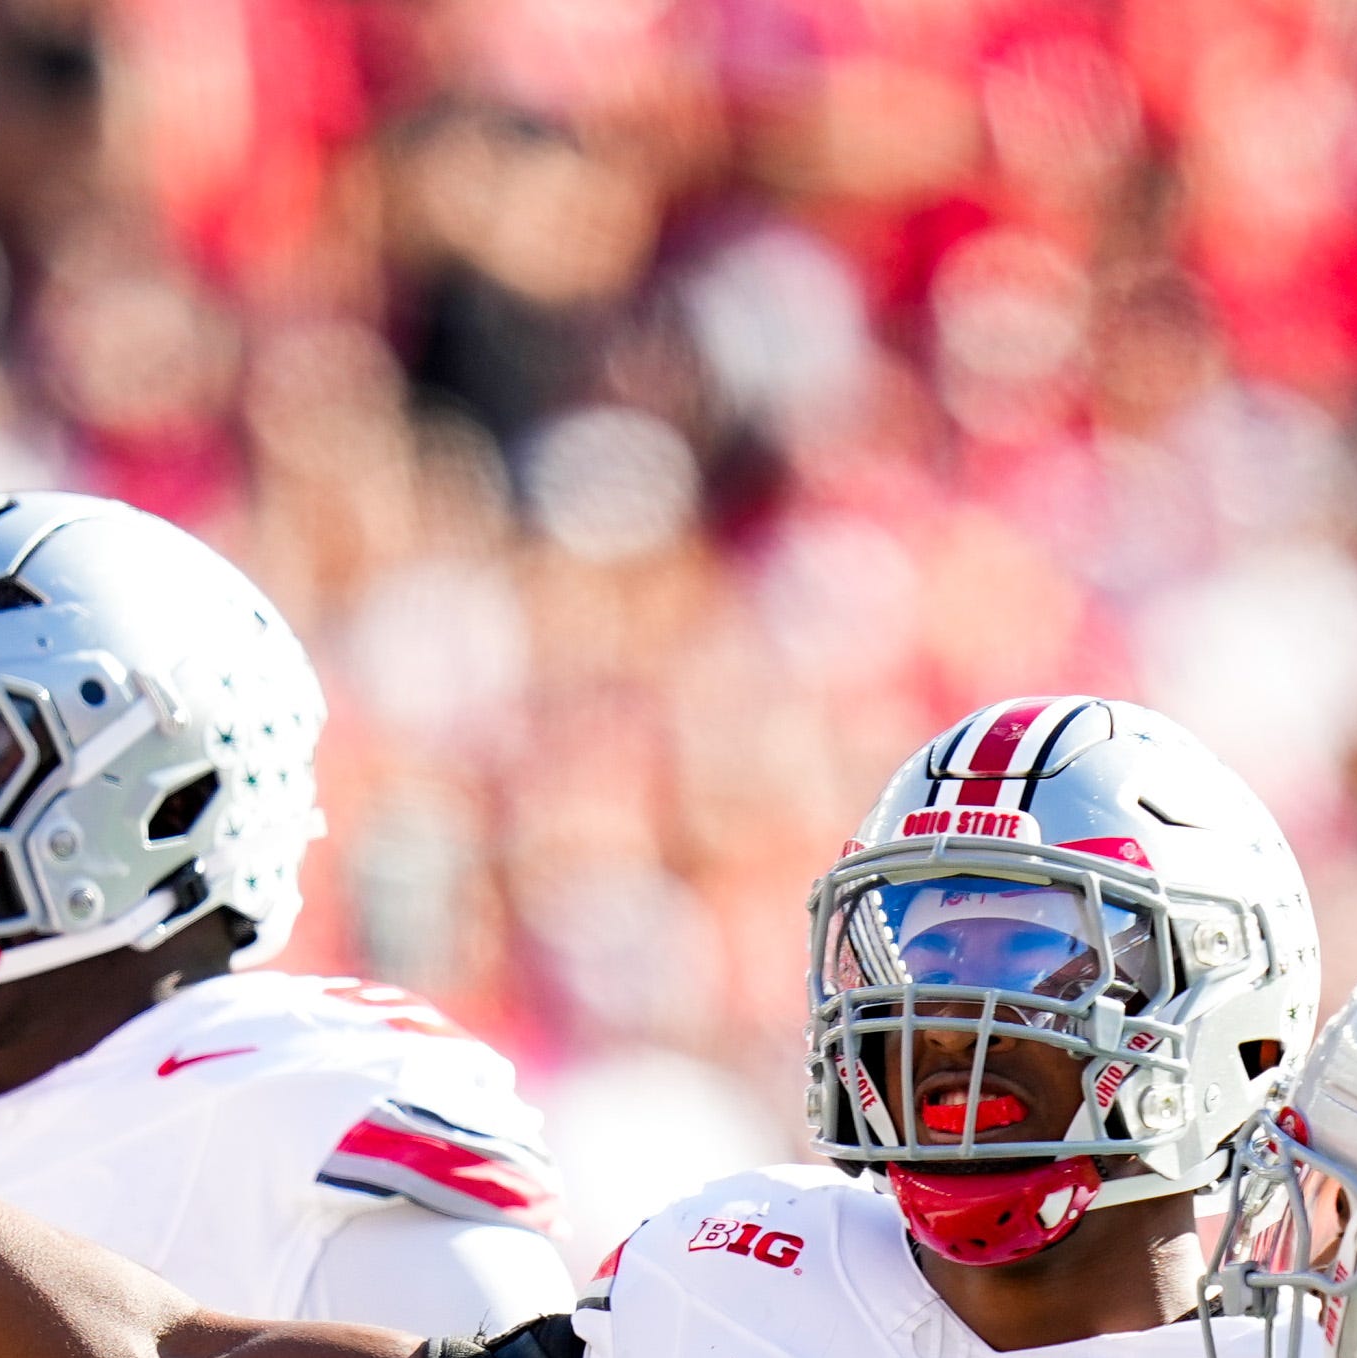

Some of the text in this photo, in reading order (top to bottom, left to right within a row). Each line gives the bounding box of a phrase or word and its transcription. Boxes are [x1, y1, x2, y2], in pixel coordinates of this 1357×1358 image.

[903, 810, 1020, 838] OHIO STATE
[1096, 1066, 1123, 1107] OHIO
